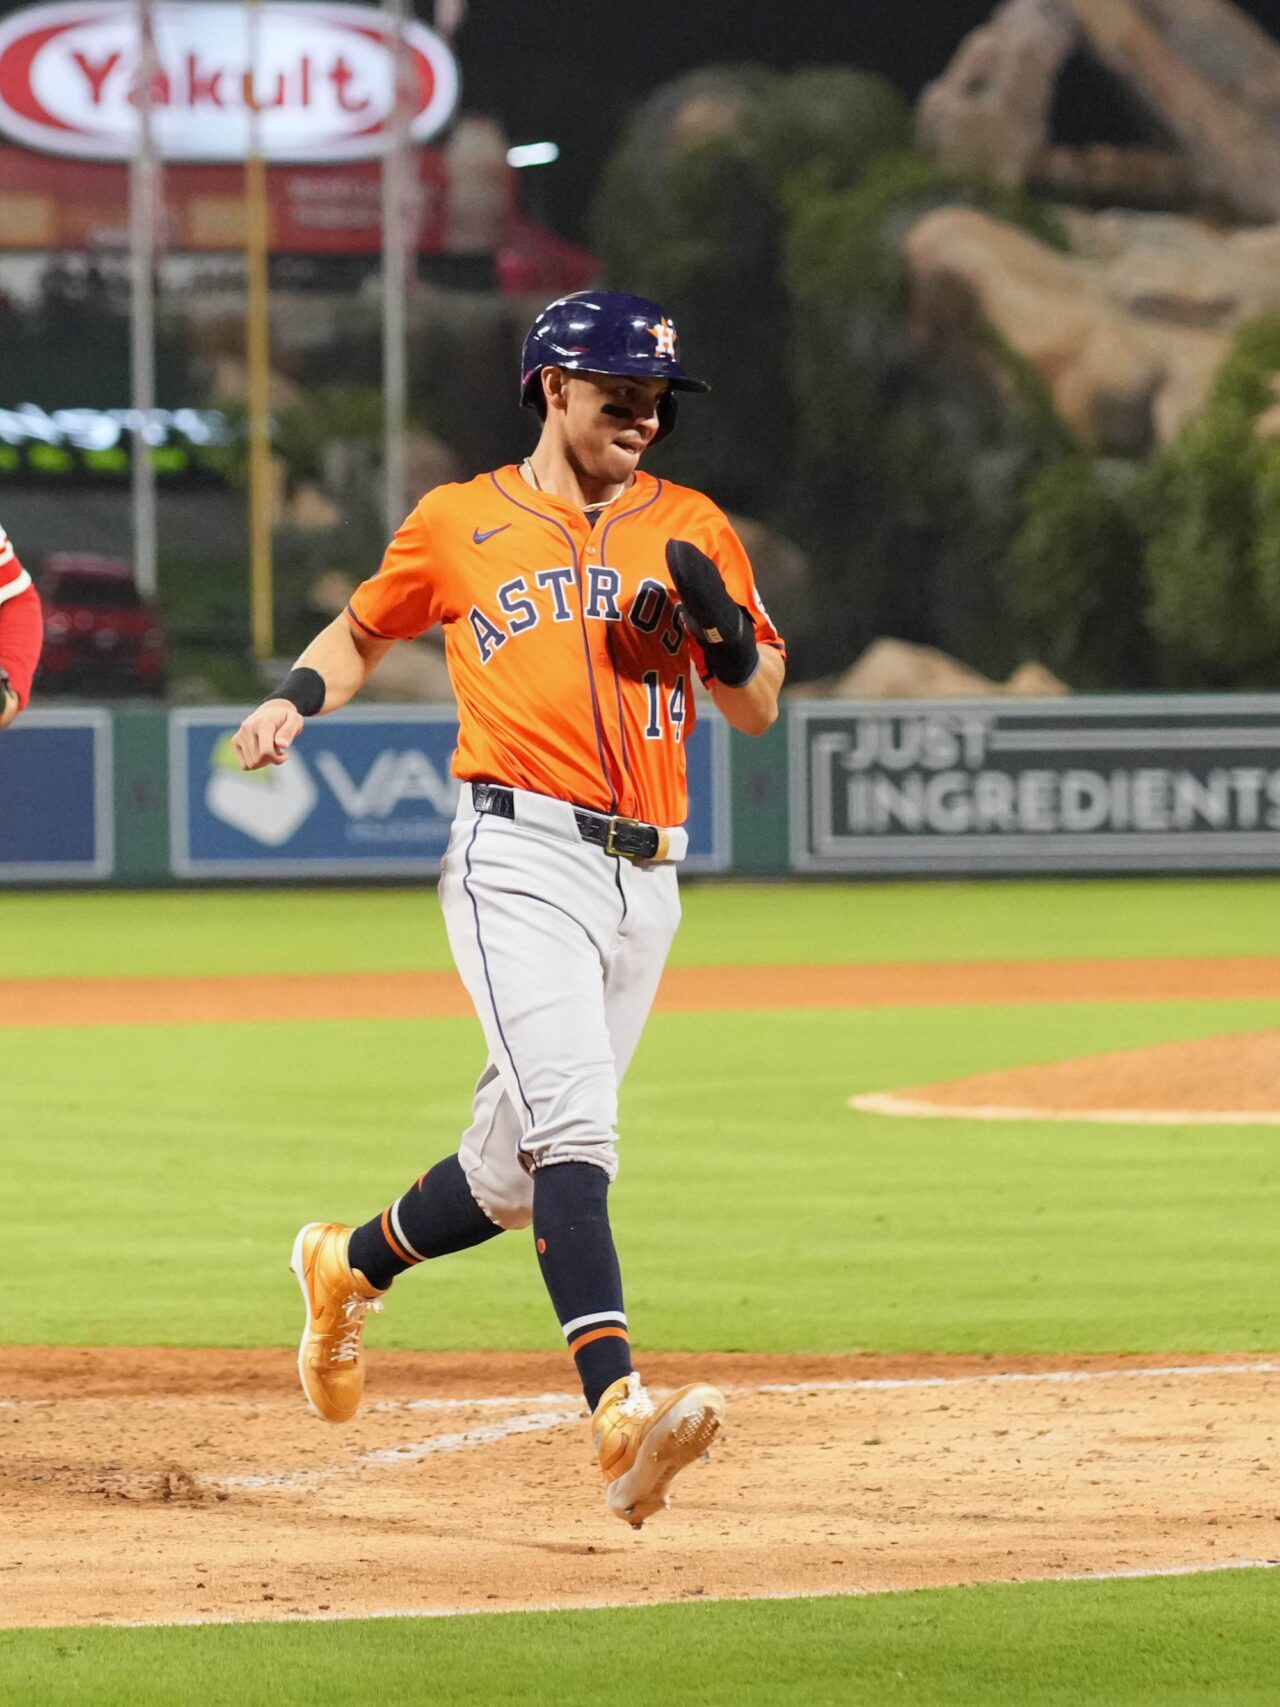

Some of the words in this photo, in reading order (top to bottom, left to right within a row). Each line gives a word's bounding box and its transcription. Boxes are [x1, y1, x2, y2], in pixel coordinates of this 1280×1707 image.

[69, 50, 373, 112] Yakult
[469, 563, 685, 664] ASTROS
[642, 668, 686, 743] 14
[841, 715, 994, 770] JUST
[316, 749, 458, 819] VA
